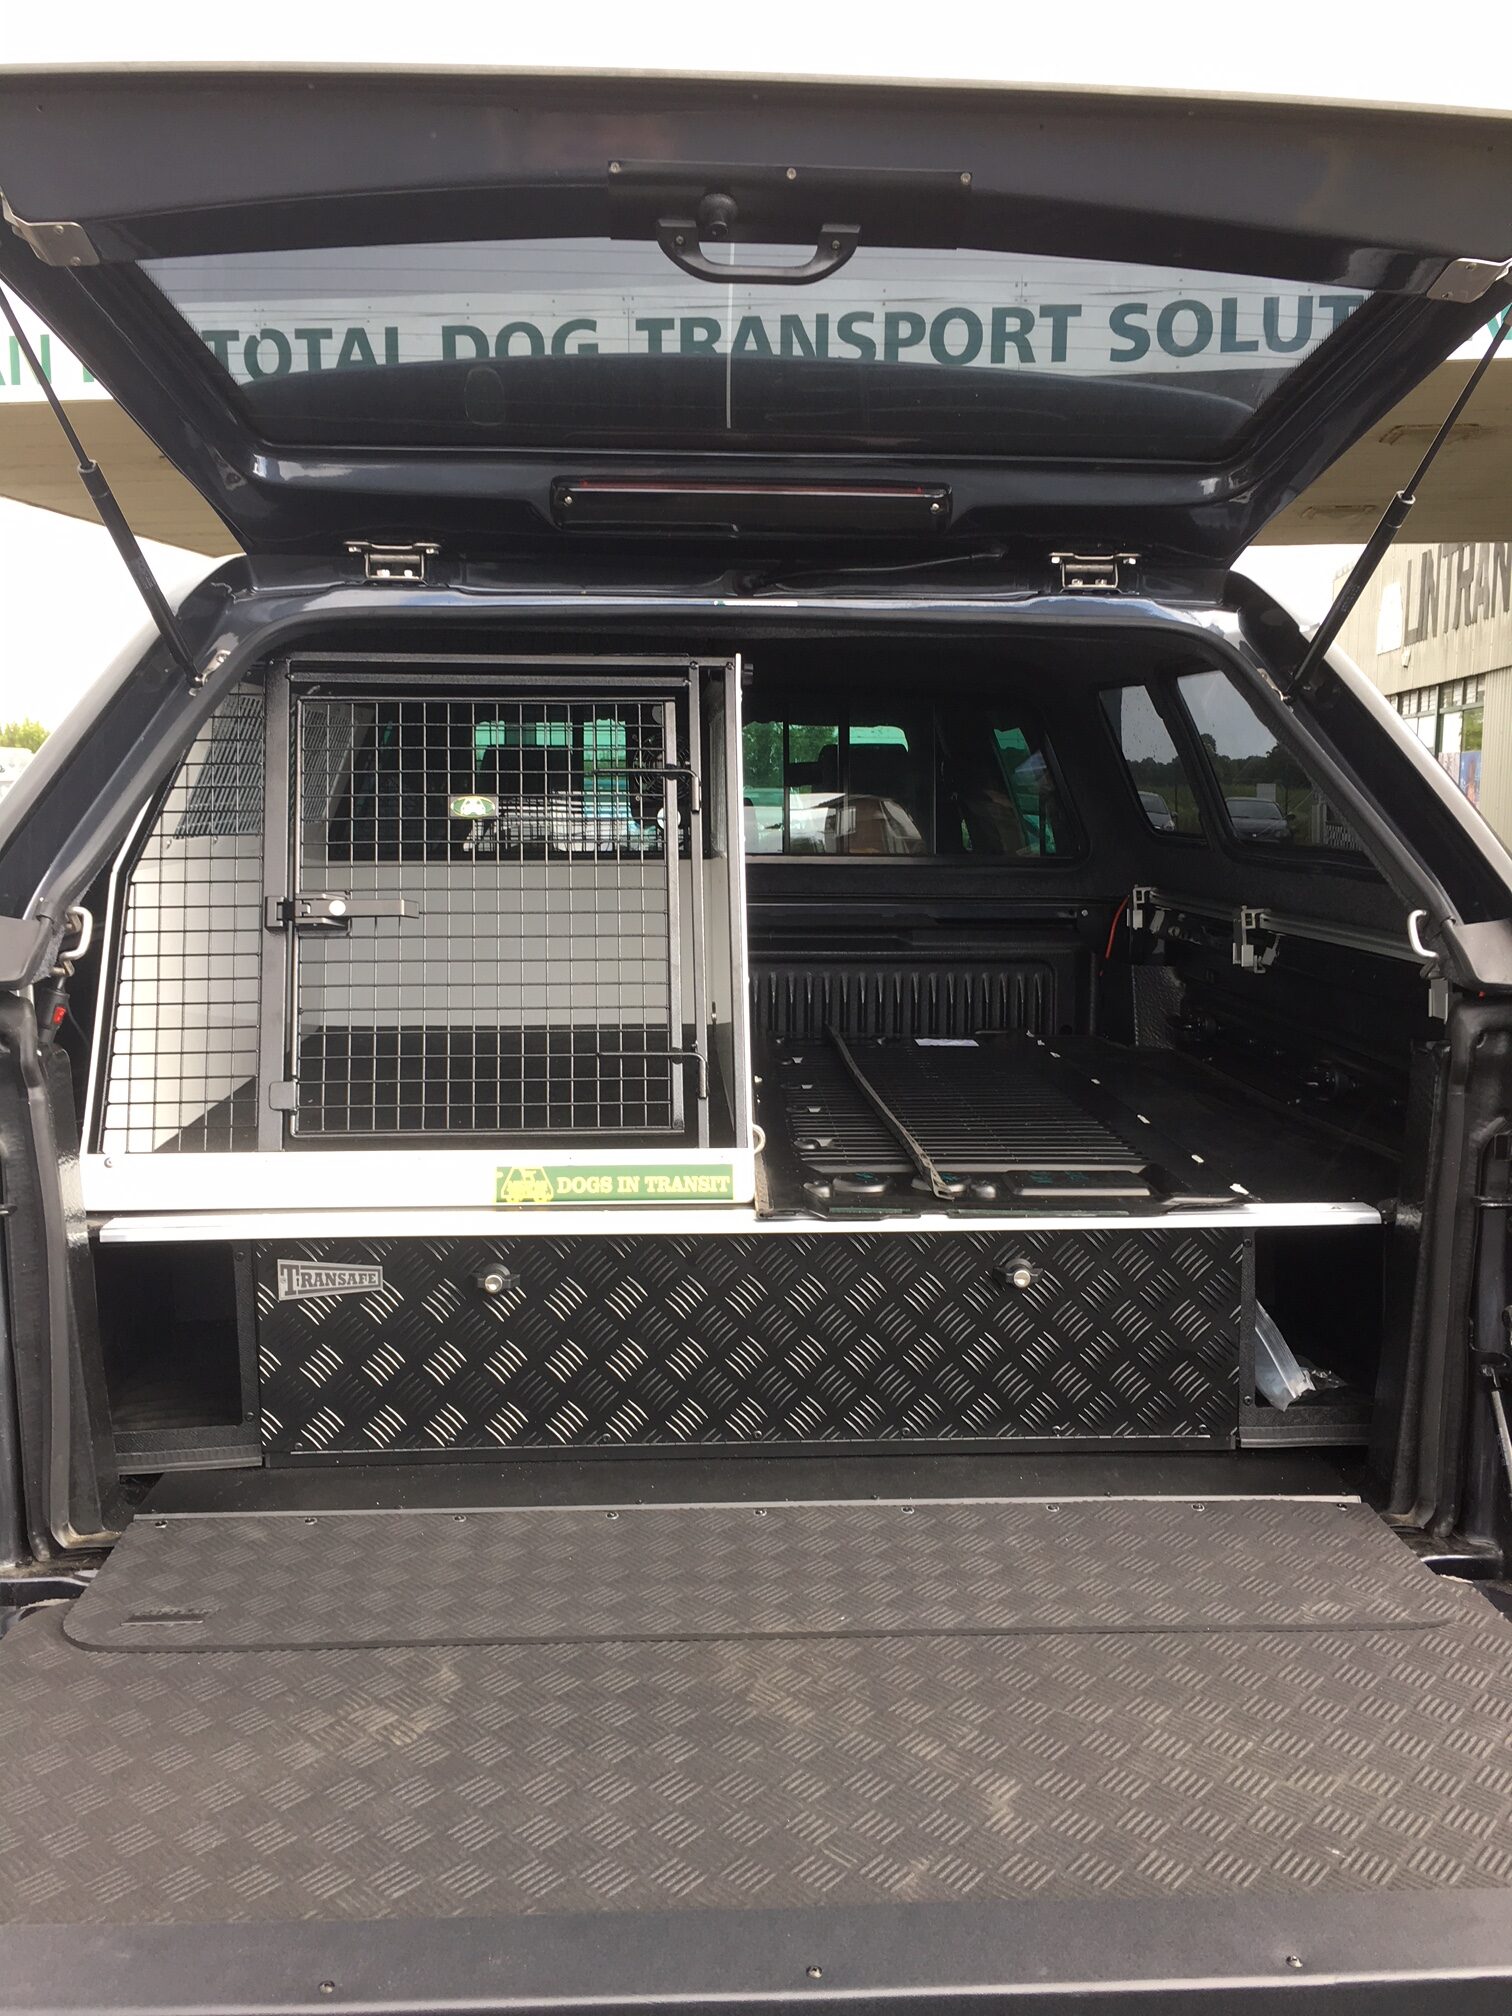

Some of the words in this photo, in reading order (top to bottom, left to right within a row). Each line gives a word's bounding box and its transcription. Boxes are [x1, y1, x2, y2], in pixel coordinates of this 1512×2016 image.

[441, 318, 598, 359] DOG
[635, 303, 1081, 366] TRANSPORT
[556, 1176, 613, 1194] DOGS
[617, 1175, 640, 1193] IN
[645, 1175, 731, 1193] TRANSIT
[280, 1264, 377, 1296] TRANSAFE
